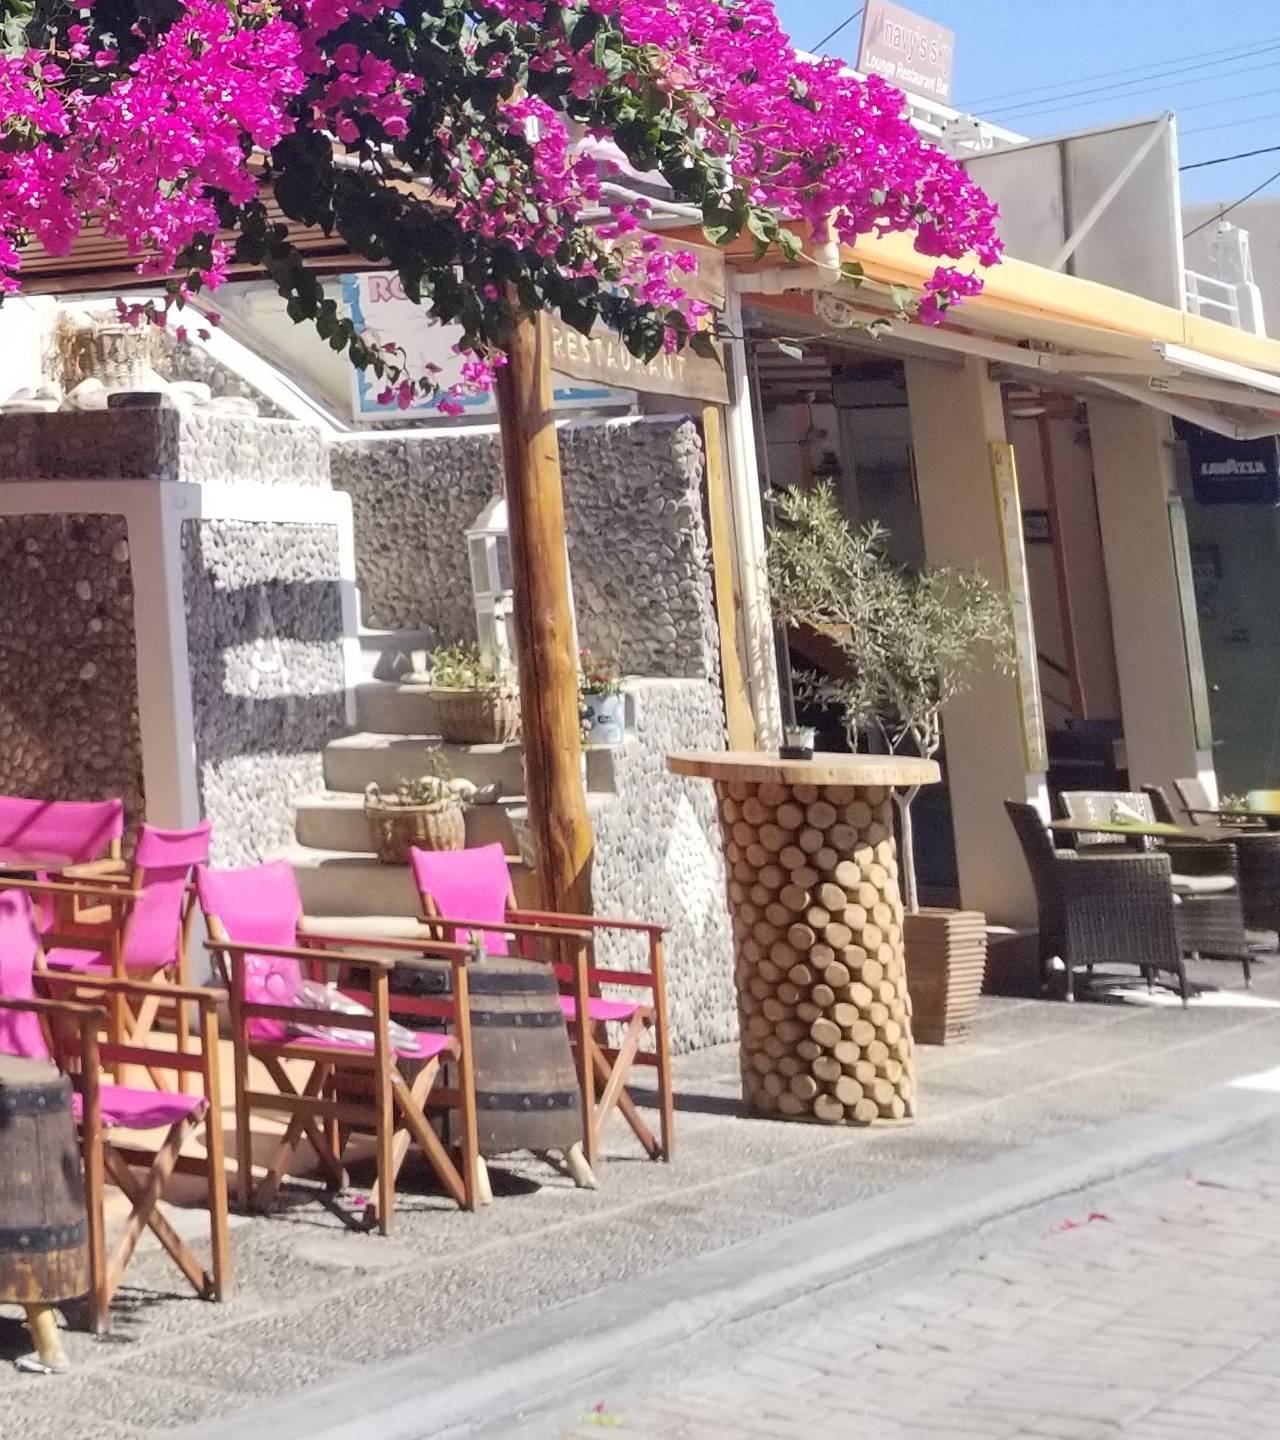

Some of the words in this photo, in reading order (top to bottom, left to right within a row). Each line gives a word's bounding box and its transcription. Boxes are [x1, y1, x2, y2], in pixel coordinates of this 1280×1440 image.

[865, 49, 896, 77] Lounge
[896, 62, 936, 93] Restaurant
[936, 77, 949, 96] Bar
